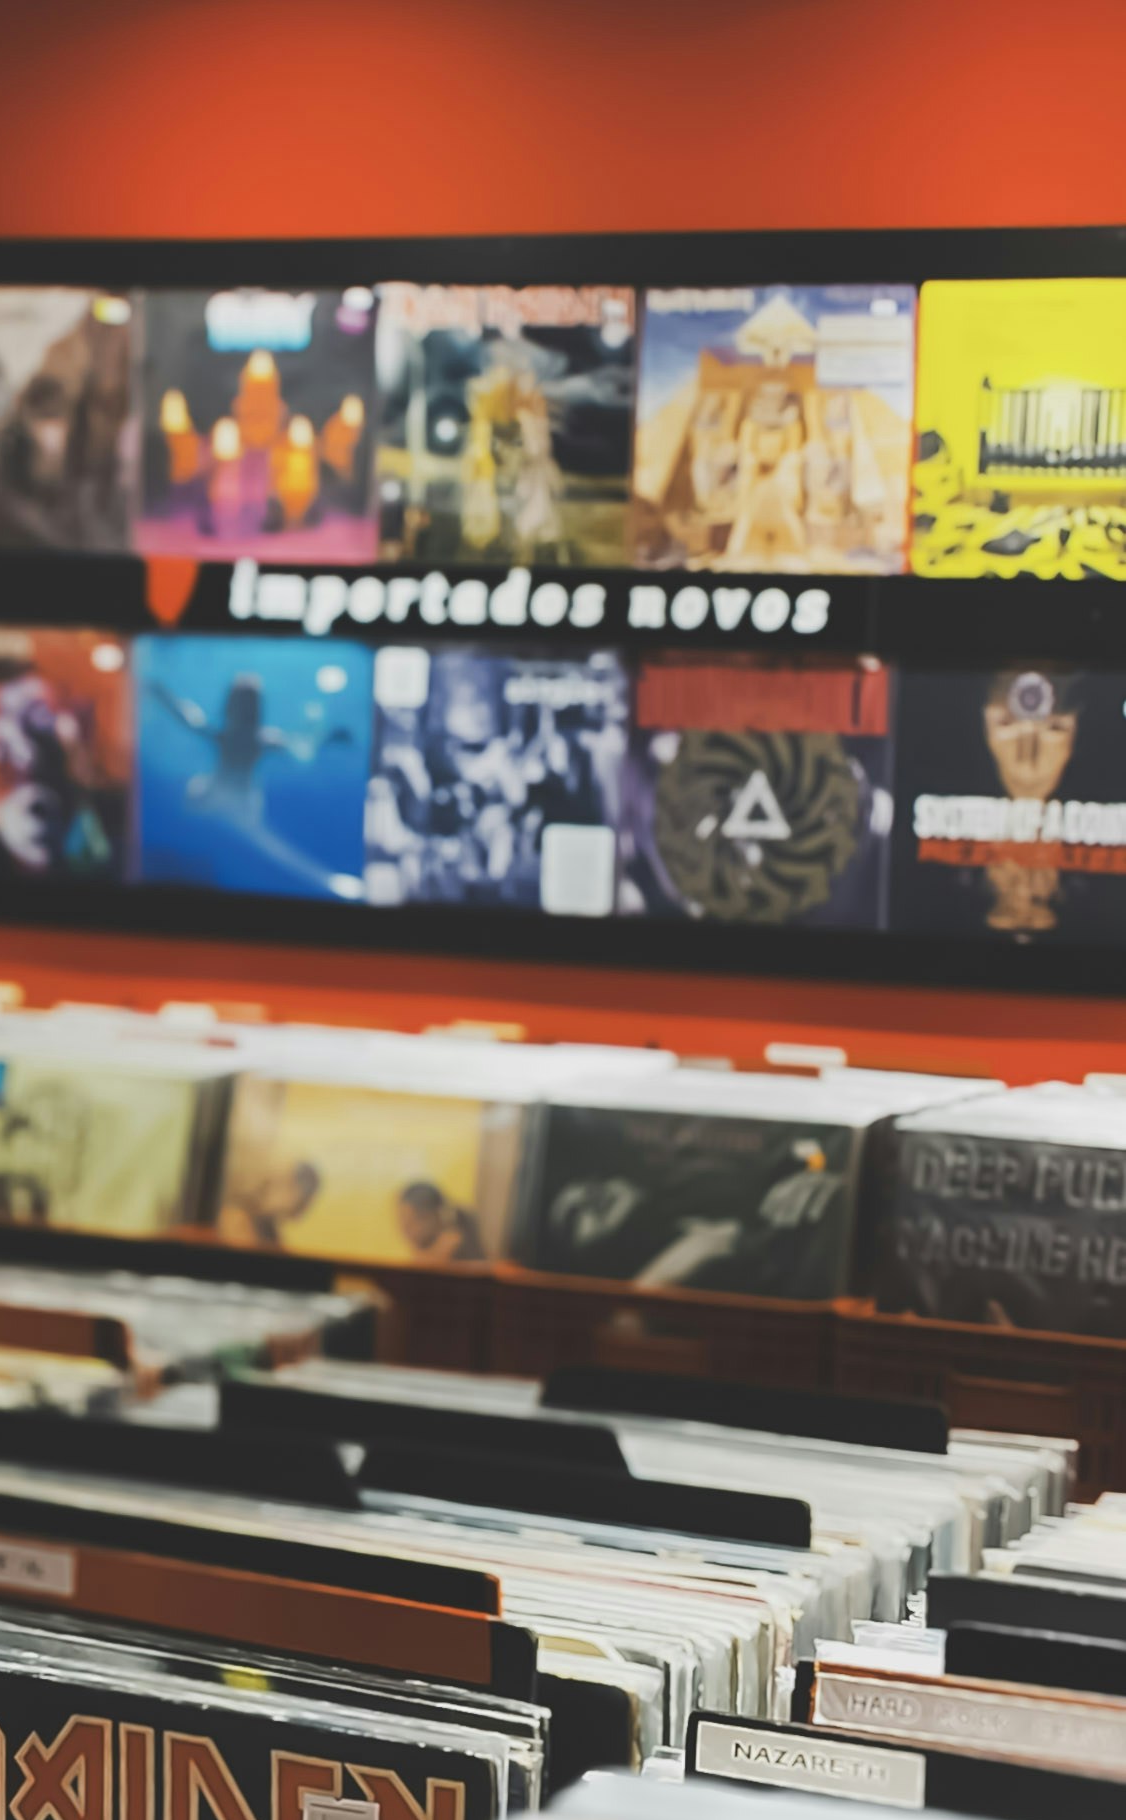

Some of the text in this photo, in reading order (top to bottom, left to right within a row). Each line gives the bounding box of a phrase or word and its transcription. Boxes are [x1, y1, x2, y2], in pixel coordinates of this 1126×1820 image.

[229, 557, 831, 637] Importados novos
[734, 1742, 888, 1782] NAZARETH
